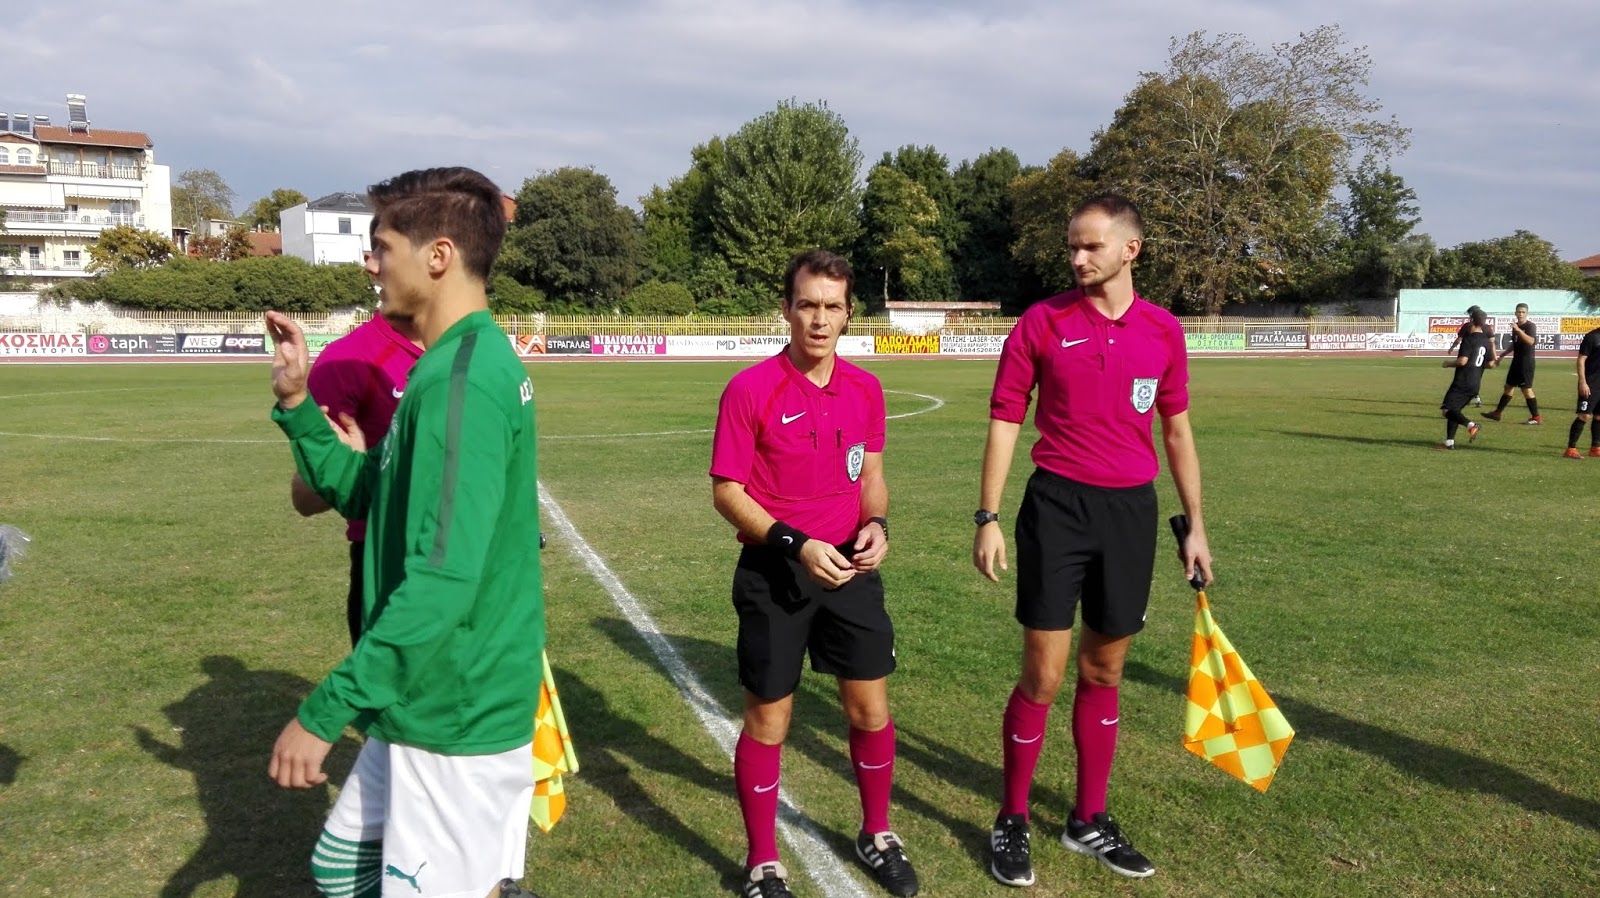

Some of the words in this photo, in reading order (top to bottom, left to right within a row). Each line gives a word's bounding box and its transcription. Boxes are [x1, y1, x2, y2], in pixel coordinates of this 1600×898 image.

[189, 337, 218, 346] WEG
[1309, 333, 1366, 342] ΚΡΕΟΠΩΛΕΙΟ
[1475, 346, 1486, 367] 8
[1581, 401, 1589, 411] 3
